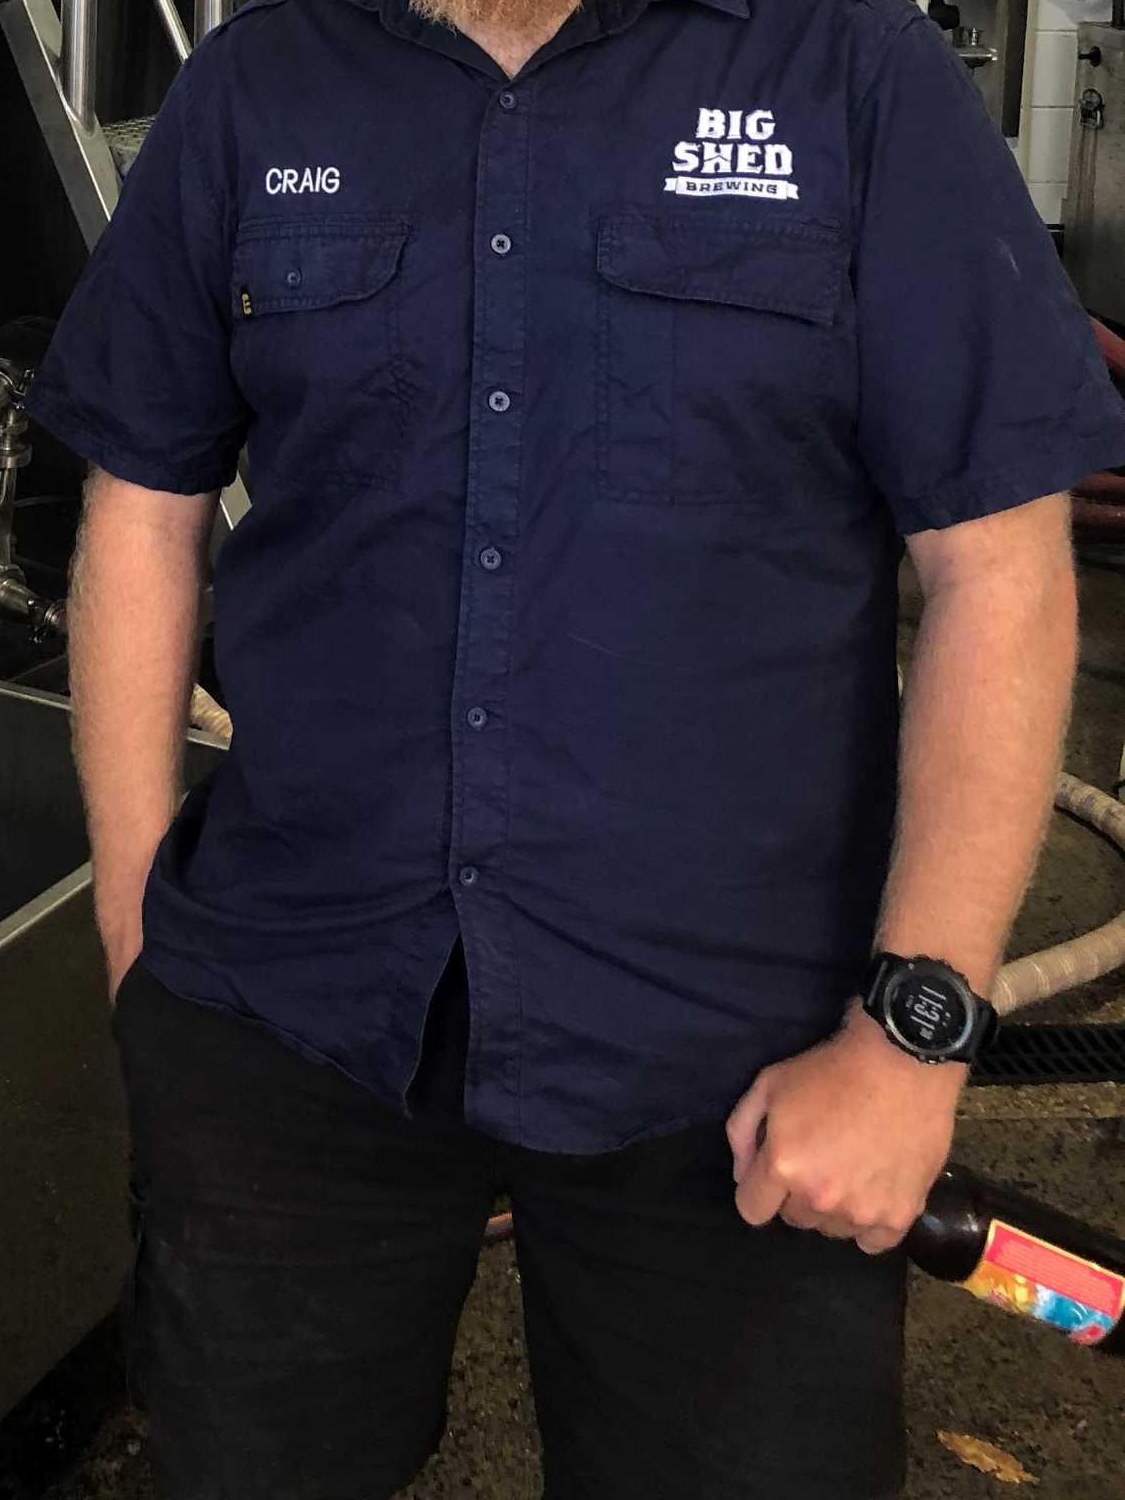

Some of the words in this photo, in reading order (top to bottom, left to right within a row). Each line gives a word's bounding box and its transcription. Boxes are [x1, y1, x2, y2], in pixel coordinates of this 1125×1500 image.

[696, 107, 776, 141] BIG
[672, 141, 793, 175] SHED
[266, 167, 341, 194] CRAIG
[686, 181, 778, 195] BREWING
